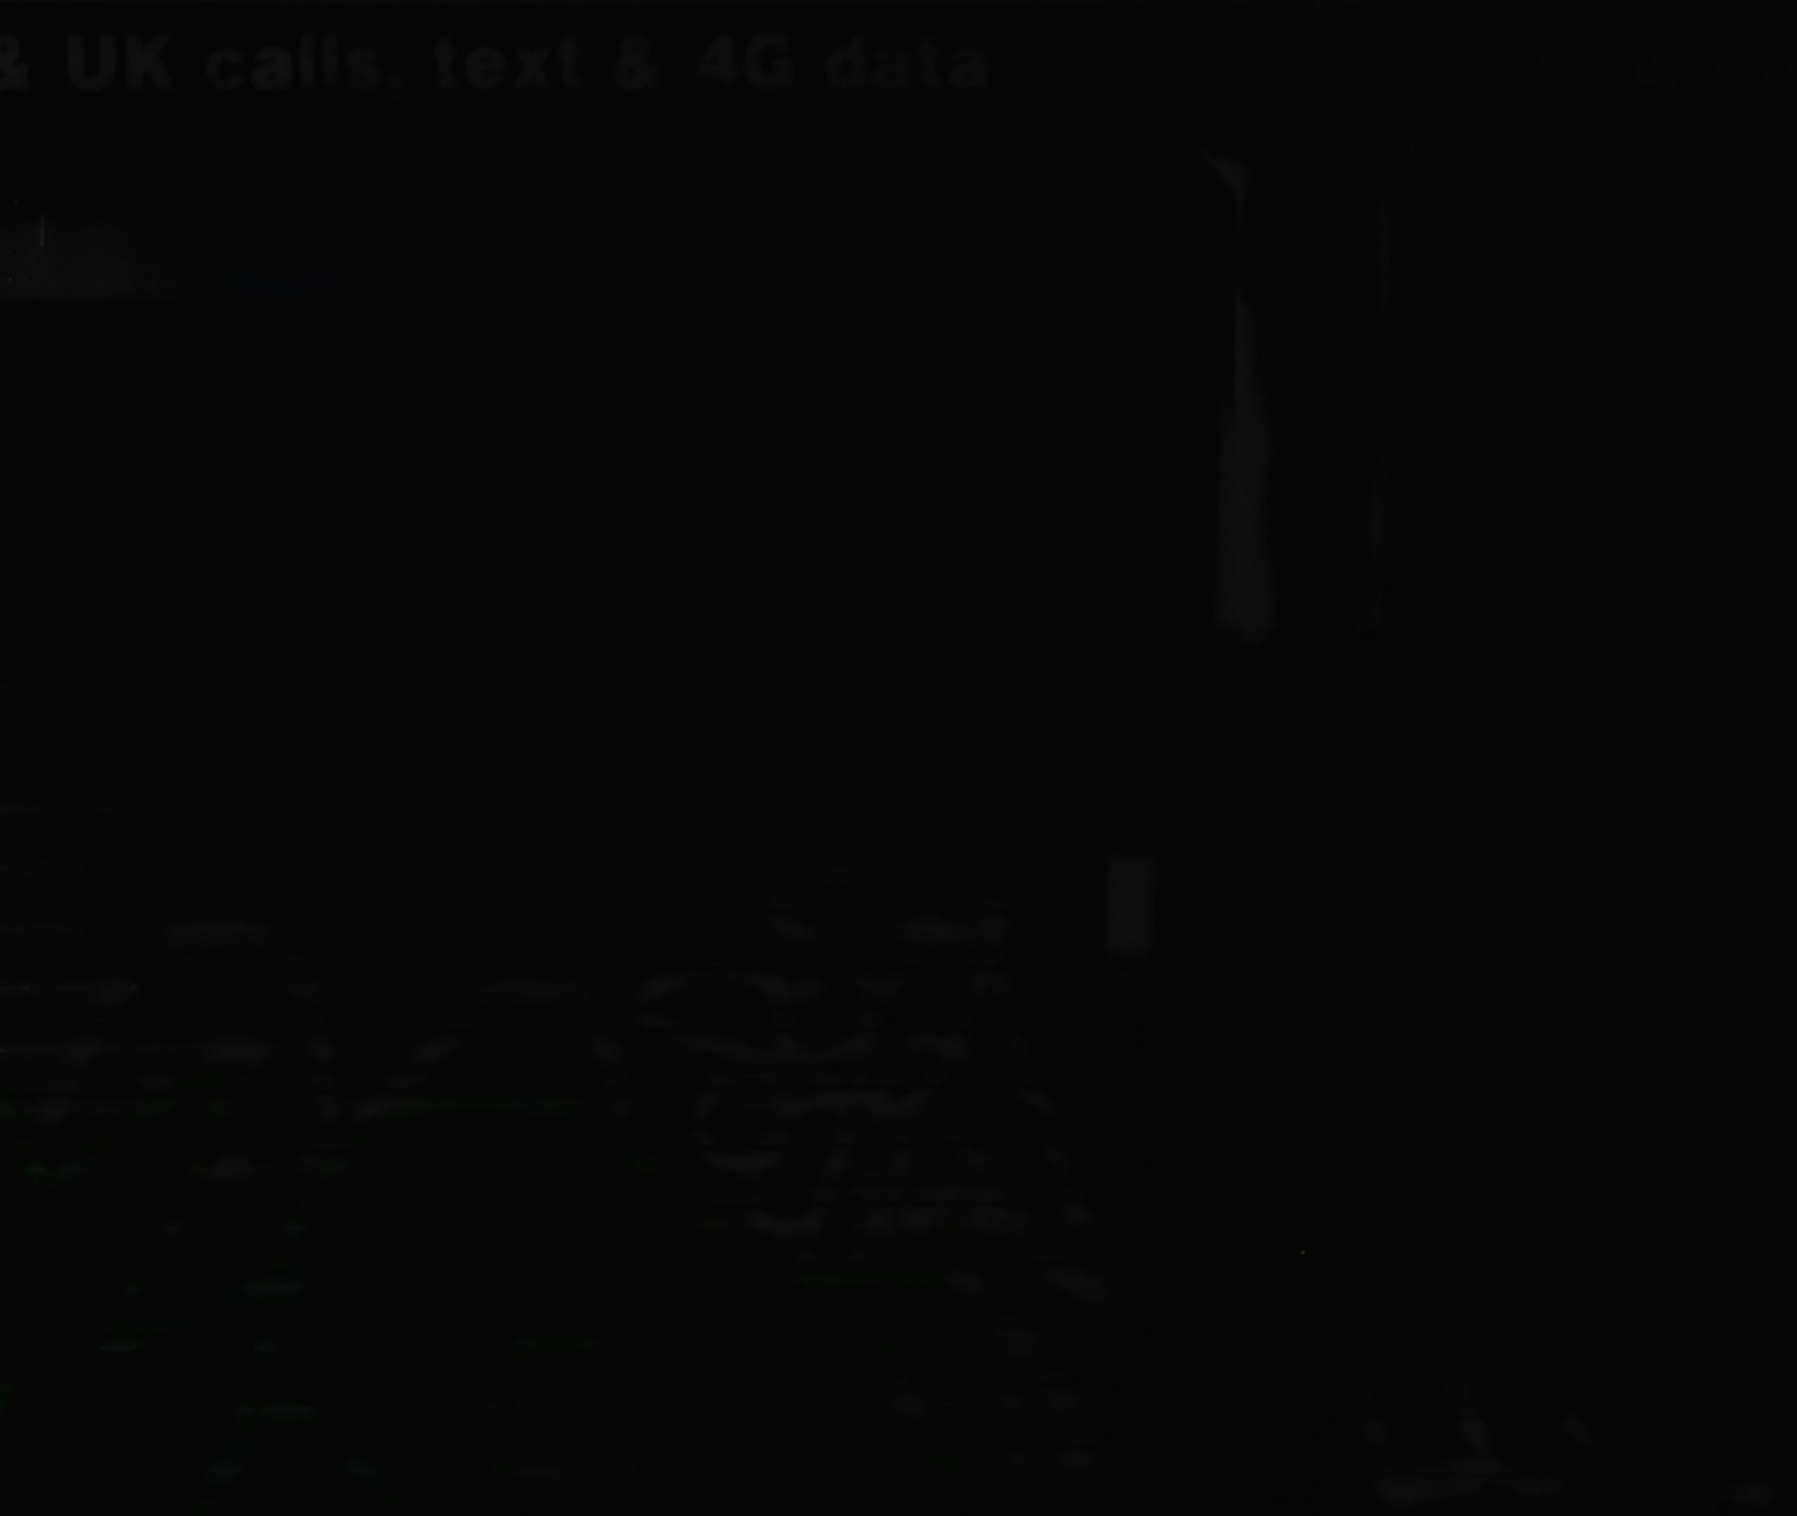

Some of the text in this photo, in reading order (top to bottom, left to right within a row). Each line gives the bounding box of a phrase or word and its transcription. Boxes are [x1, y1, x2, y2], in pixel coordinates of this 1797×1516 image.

[66, 33, 174, 92] UK
[204, 33, 402, 99] calls,
[432, 35, 581, 90] text
[613, 34, 659, 91] &
[697, 31, 794, 89] 4G
[825, 33, 988, 88] data
